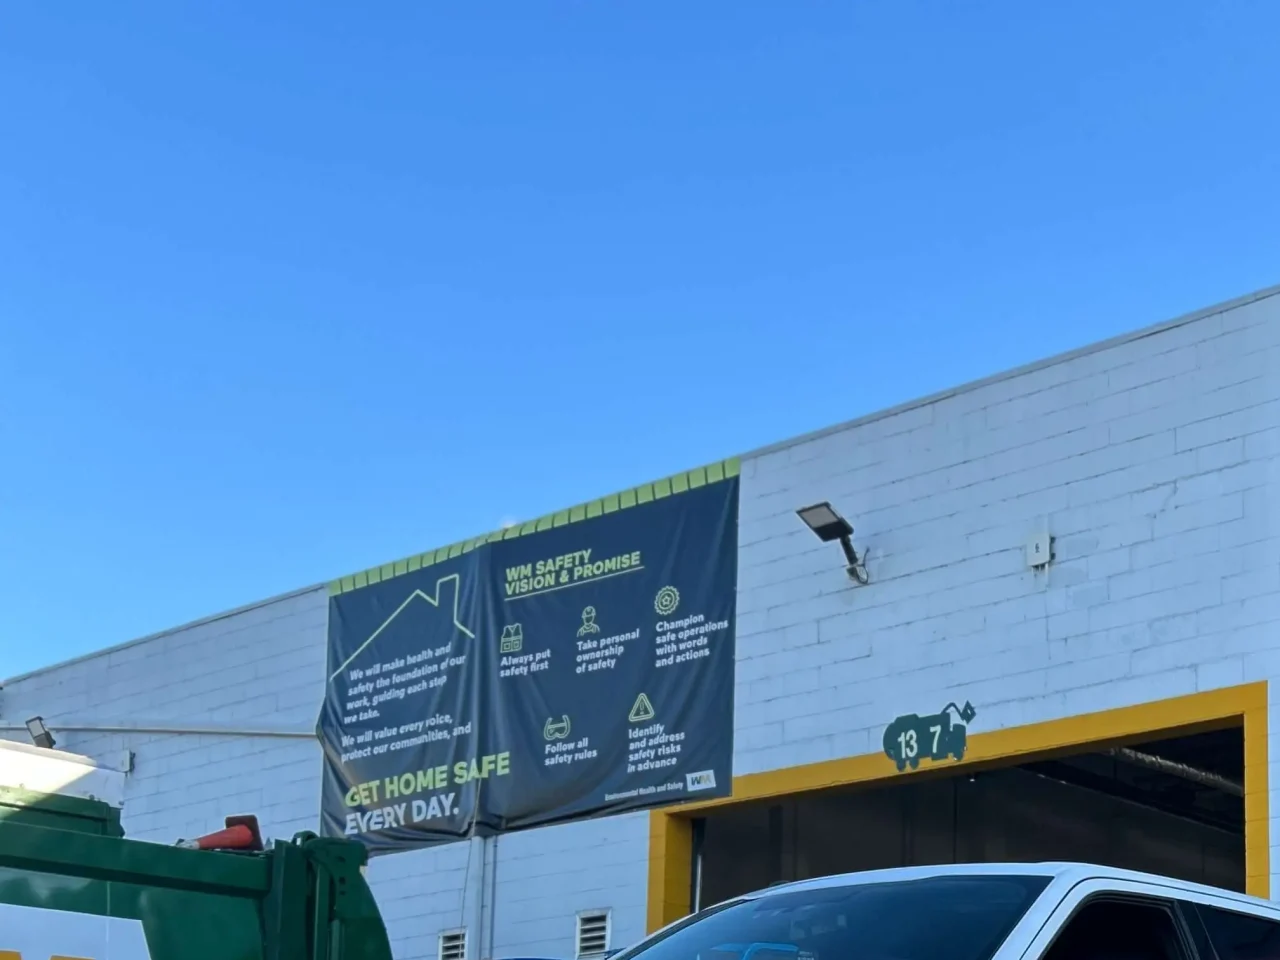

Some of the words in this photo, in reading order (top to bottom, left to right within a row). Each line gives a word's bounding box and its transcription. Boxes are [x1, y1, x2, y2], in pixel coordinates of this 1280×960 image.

[505, 572, 556, 596] VISION
[559, 570, 569, 584] &
[574, 551, 641, 580] PROMISE
[506, 564, 532, 582] WM
[536, 548, 592, 575] SAFETY
[656, 614, 704, 632] Champion
[656, 632, 676, 644] safe
[678, 620, 729, 640] operations
[576, 638, 598, 651] Take
[600, 628, 640, 649] personal
[656, 644, 677, 656] with
[679, 636, 708, 650] words
[350, 669, 364, 680] We
[365, 663, 381, 676] will
[382, 658, 405, 672] make
[406, 648, 433, 666] health
[434, 642, 452, 656] and
[500, 652, 534, 667] Always
[536, 649, 551, 662] put
[576, 645, 624, 662] ownership
[655, 654, 674, 668] and
[675, 648, 710, 664] actions
[500, 664, 528, 677] safety
[530, 660, 549, 671] first
[576, 662, 586, 674] of
[588, 658, 616, 672] safety
[348, 682, 374, 696] safety
[376, 676, 390, 688] the
[392, 663, 438, 684] foundation
[440, 658, 449, 670] of
[450, 656, 466, 666] our
[346, 696, 371, 710] work,
[372, 687, 406, 706] guiding
[407, 680, 428, 694] each
[429, 675, 448, 688] step
[344, 714, 358, 724] we
[359, 709, 380, 721] take.
[341, 735, 355, 748] We
[356, 730, 372, 744] will
[374, 726, 398, 740] value
[400, 720, 424, 734] every
[628, 724, 665, 740] Identify
[629, 738, 646, 750] and
[648, 732, 686, 746] address
[897, 729, 918, 758] 13
[930, 724, 942, 754] 7
[341, 747, 371, 765] protect
[373, 744, 388, 755] our
[390, 729, 451, 751] communities,
[452, 722, 472, 736] and
[544, 742, 575, 754] Follow
[577, 737, 589, 748] all
[628, 749, 656, 762] safety
[658, 744, 681, 755] risks
[544, 753, 573, 766] safety
[574, 748, 598, 760] rules
[627, 763, 636, 774] in
[637, 757, 677, 772] advance
[344, 780, 380, 807] GET
[384, 764, 448, 799] HOME
[453, 751, 510, 784] SAFE
[657, 784, 666, 792] and
[667, 782, 684, 790] Safety
[691, 774, 712, 786] WM
[344, 803, 407, 835] EVERY
[411, 792, 459, 823] DAY.
